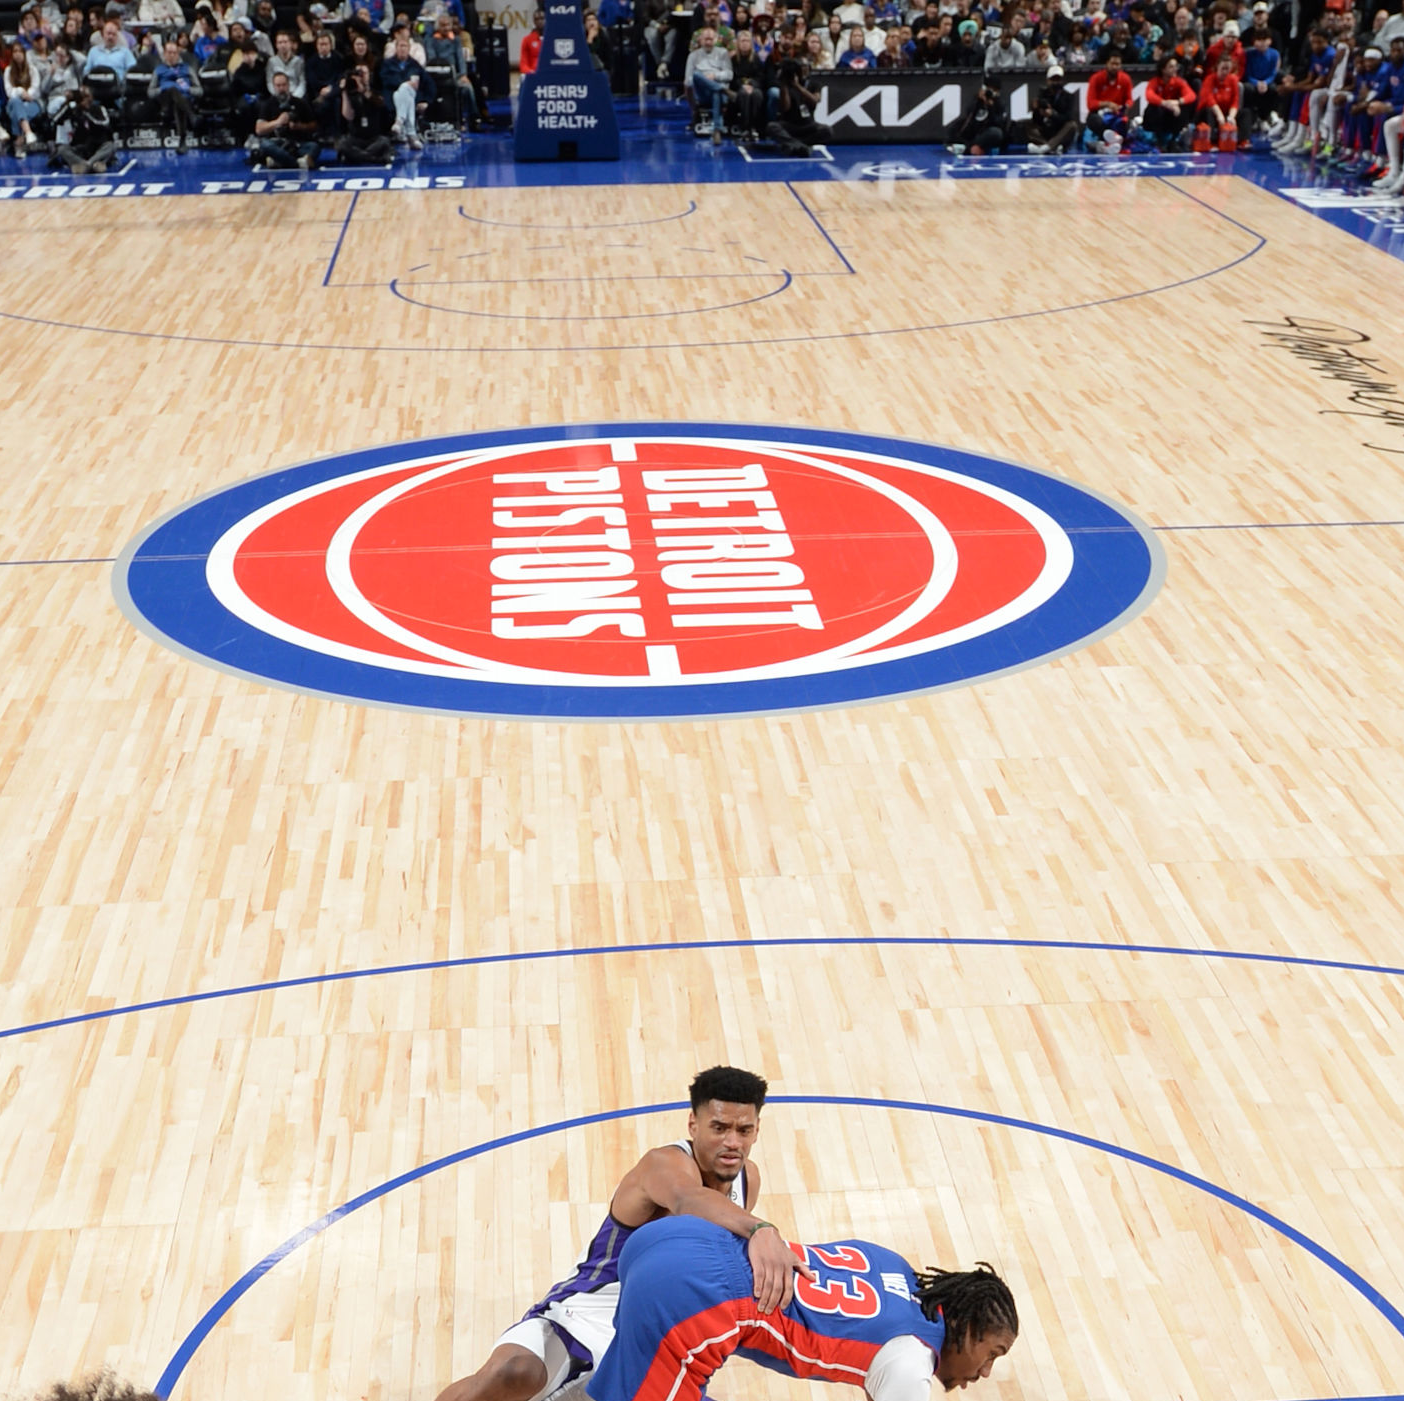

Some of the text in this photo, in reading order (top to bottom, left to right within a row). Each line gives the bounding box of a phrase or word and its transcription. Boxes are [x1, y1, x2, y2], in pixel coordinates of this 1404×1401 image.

[534, 85, 588, 98] HENRY
[537, 101, 577, 114] FORD
[538, 115, 598, 128] HEALTH
[201, 176, 467, 193] PISTONS
[490, 466, 646, 640] PISTONS
[641, 463, 825, 630] DETROIT
[784, 1240, 881, 1319] 23
[879, 1272, 912, 1302] IVEY
